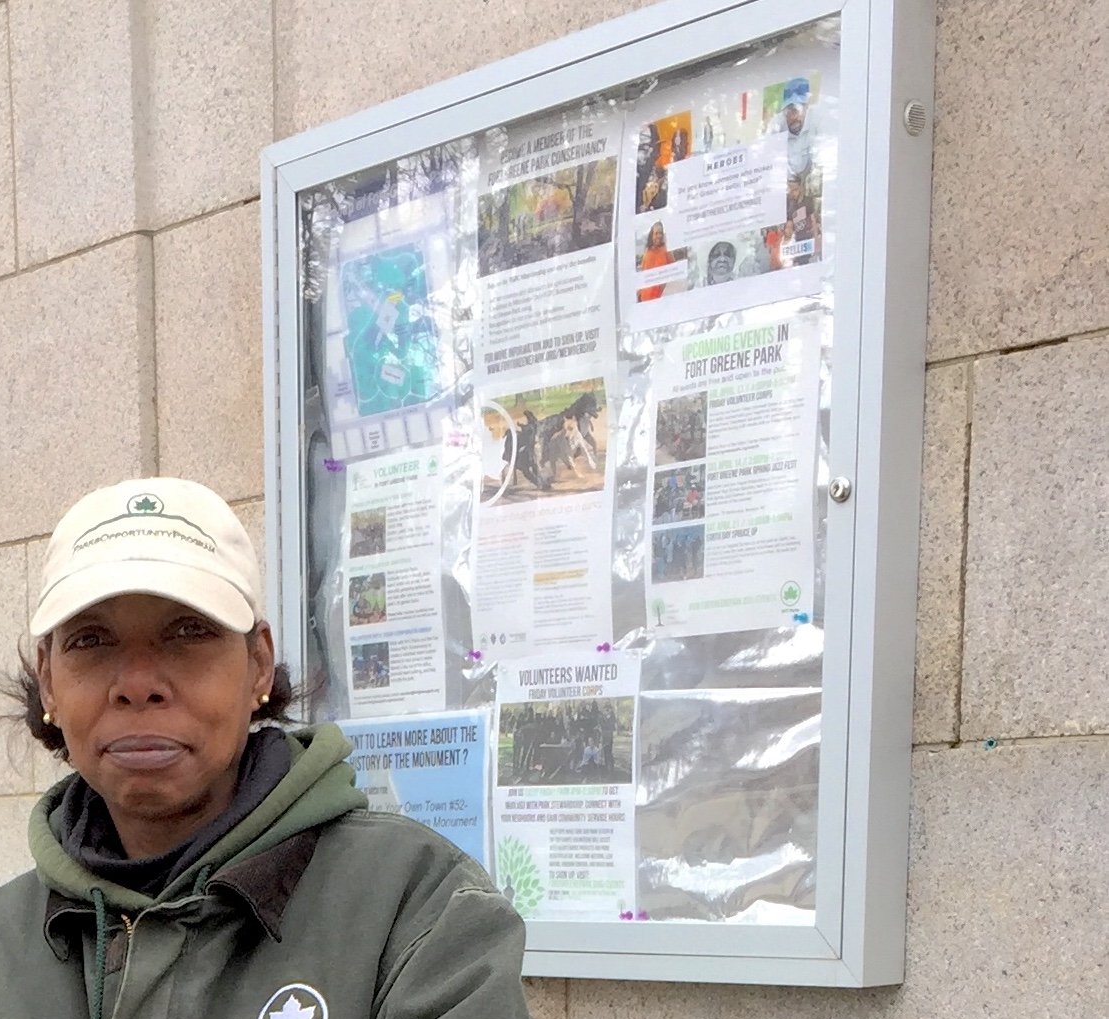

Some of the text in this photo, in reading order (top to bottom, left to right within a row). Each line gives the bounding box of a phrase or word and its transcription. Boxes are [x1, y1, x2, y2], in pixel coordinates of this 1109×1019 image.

[532, 130, 565, 152] MEMBER
[566, 127, 576, 142] OF
[578, 122, 594, 139] THE
[503, 159, 530, 179] GREENE
[531, 154, 550, 172] PARK
[551, 138, 608, 167] CONSERVANCY
[561, 332, 575, 346] SIGN
[584, 327, 600, 340] VISIT
[734, 326, 775, 350] EVENTS
[777, 323, 789, 342] IN
[685, 358, 708, 380] FORT
[710, 350, 751, 374] GREENE
[753, 344, 783, 367] PARK
[680, 382, 697, 392] events
[708, 377, 720, 385] free
[721, 374, 734, 383] and
[735, 371, 752, 381] open
[761, 366, 772, 375] the
[727, 393, 755, 406] VOLUNTEER
[756, 389, 773, 401] CORPS
[373, 460, 420, 478] VOLUNTEER
[719, 469, 738, 480] GREENE
[738, 467, 752, 477] PARK
[752, 463, 770, 475] SPRING
[772, 461, 783, 472] JAZZ
[731, 528, 750, 538] SPRUCE
[750, 526, 758, 536] UP
[519, 663, 618, 687] VOLUNTEERS WANTED
[529, 685, 603, 700] FRIDAY VOLUNTEER CORPS
[365, 733, 375, 750] TO
[377, 732, 402, 749] LEARN
[404, 729, 428, 747] MORE
[430, 726, 458, 745] ABOUT
[460, 726, 477, 743] THE
[383, 753, 392, 770] OF
[395, 752, 410, 769] THE
[412, 749, 460, 768] MONUMENT
[462, 749, 469, 765] ?
[609, 786, 619, 795] GET
[404, 801, 422, 812] Own
[425, 800, 448, 812] Town
[449, 800, 468, 811] #52-
[538, 801, 550, 809] PARK
[585, 800, 608, 809] CONNECT
[608, 799, 621, 808] WITH
[433, 816, 478, 828] Monument
[558, 813, 586, 822] COMMUNITY
[587, 813, 608, 822] SERVICE
[555, 870, 567, 879] SIGN
